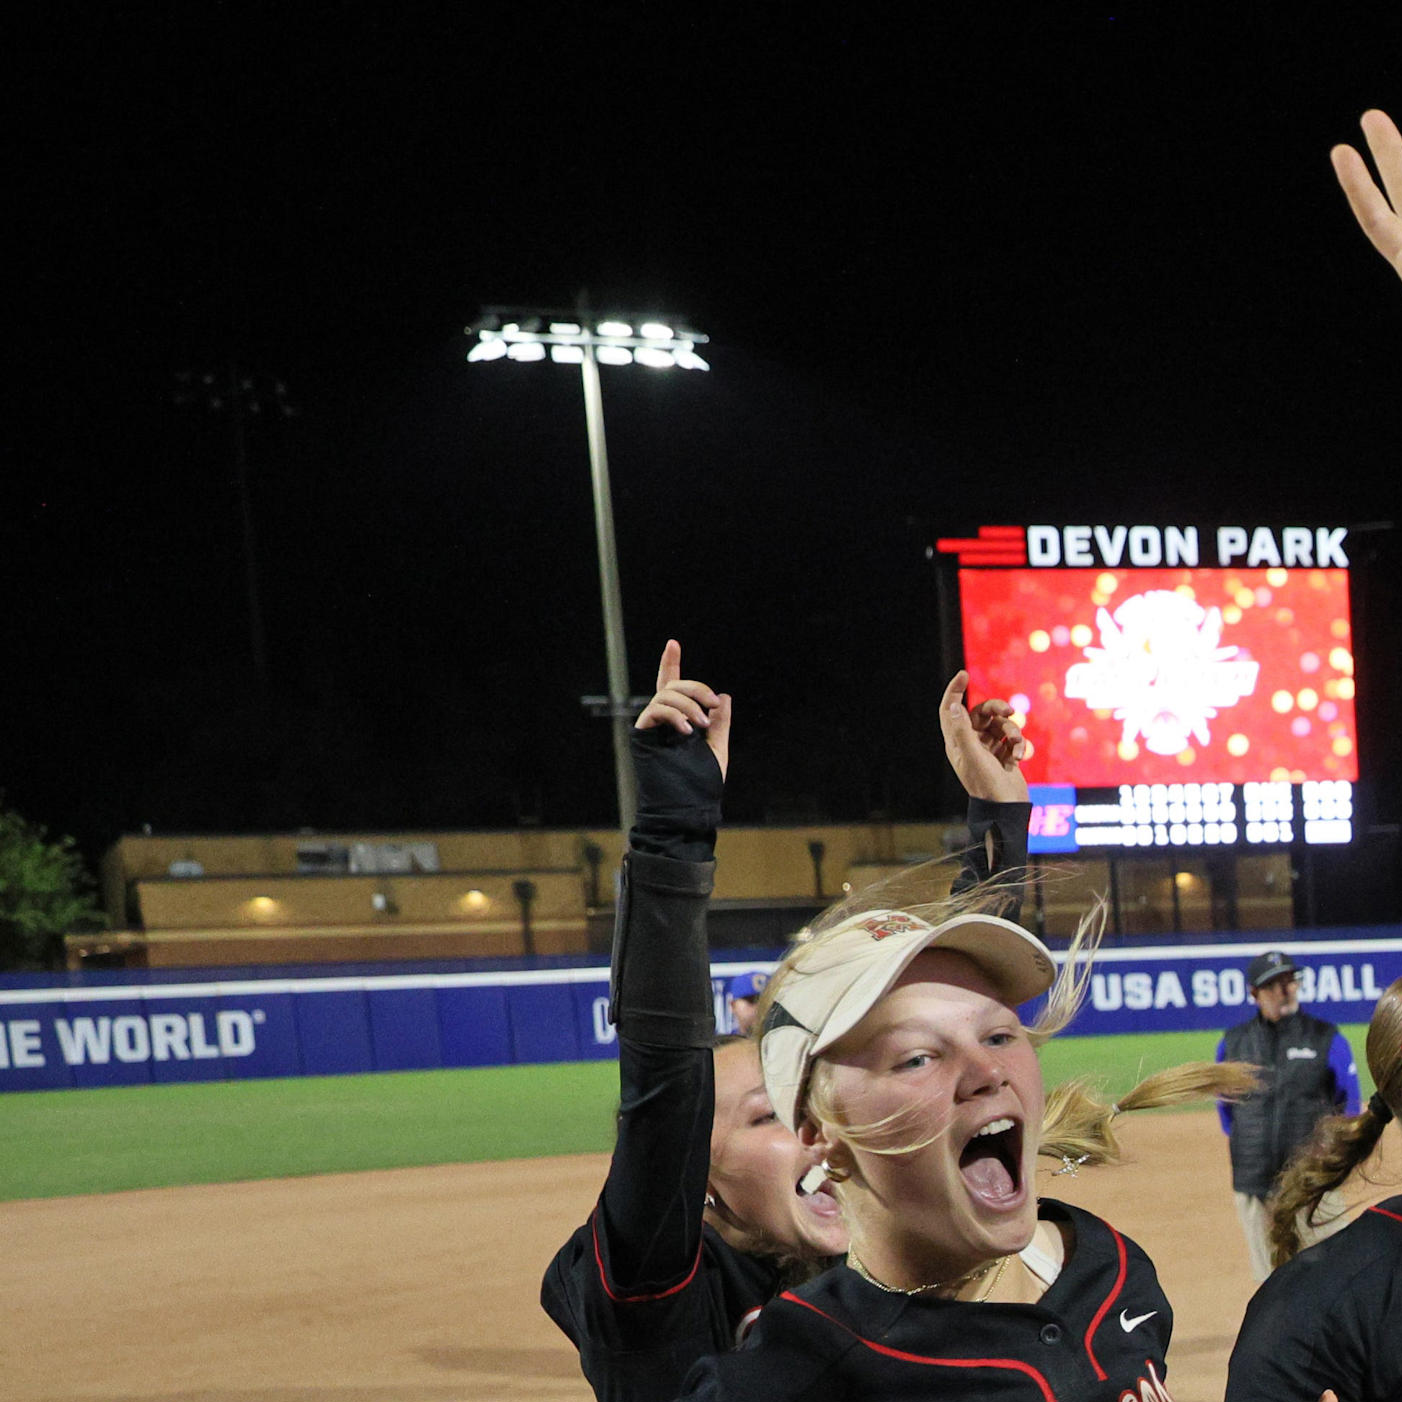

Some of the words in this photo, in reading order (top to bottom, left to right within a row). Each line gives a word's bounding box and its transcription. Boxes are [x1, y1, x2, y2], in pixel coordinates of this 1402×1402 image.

[1027, 525, 1199, 567] DEVON
[1217, 526, 1350, 568] PARK
[1090, 971, 1187, 1011] USA
[1192, 964, 1384, 1008] SOBALL
[0, 1019, 46, 1069] E
